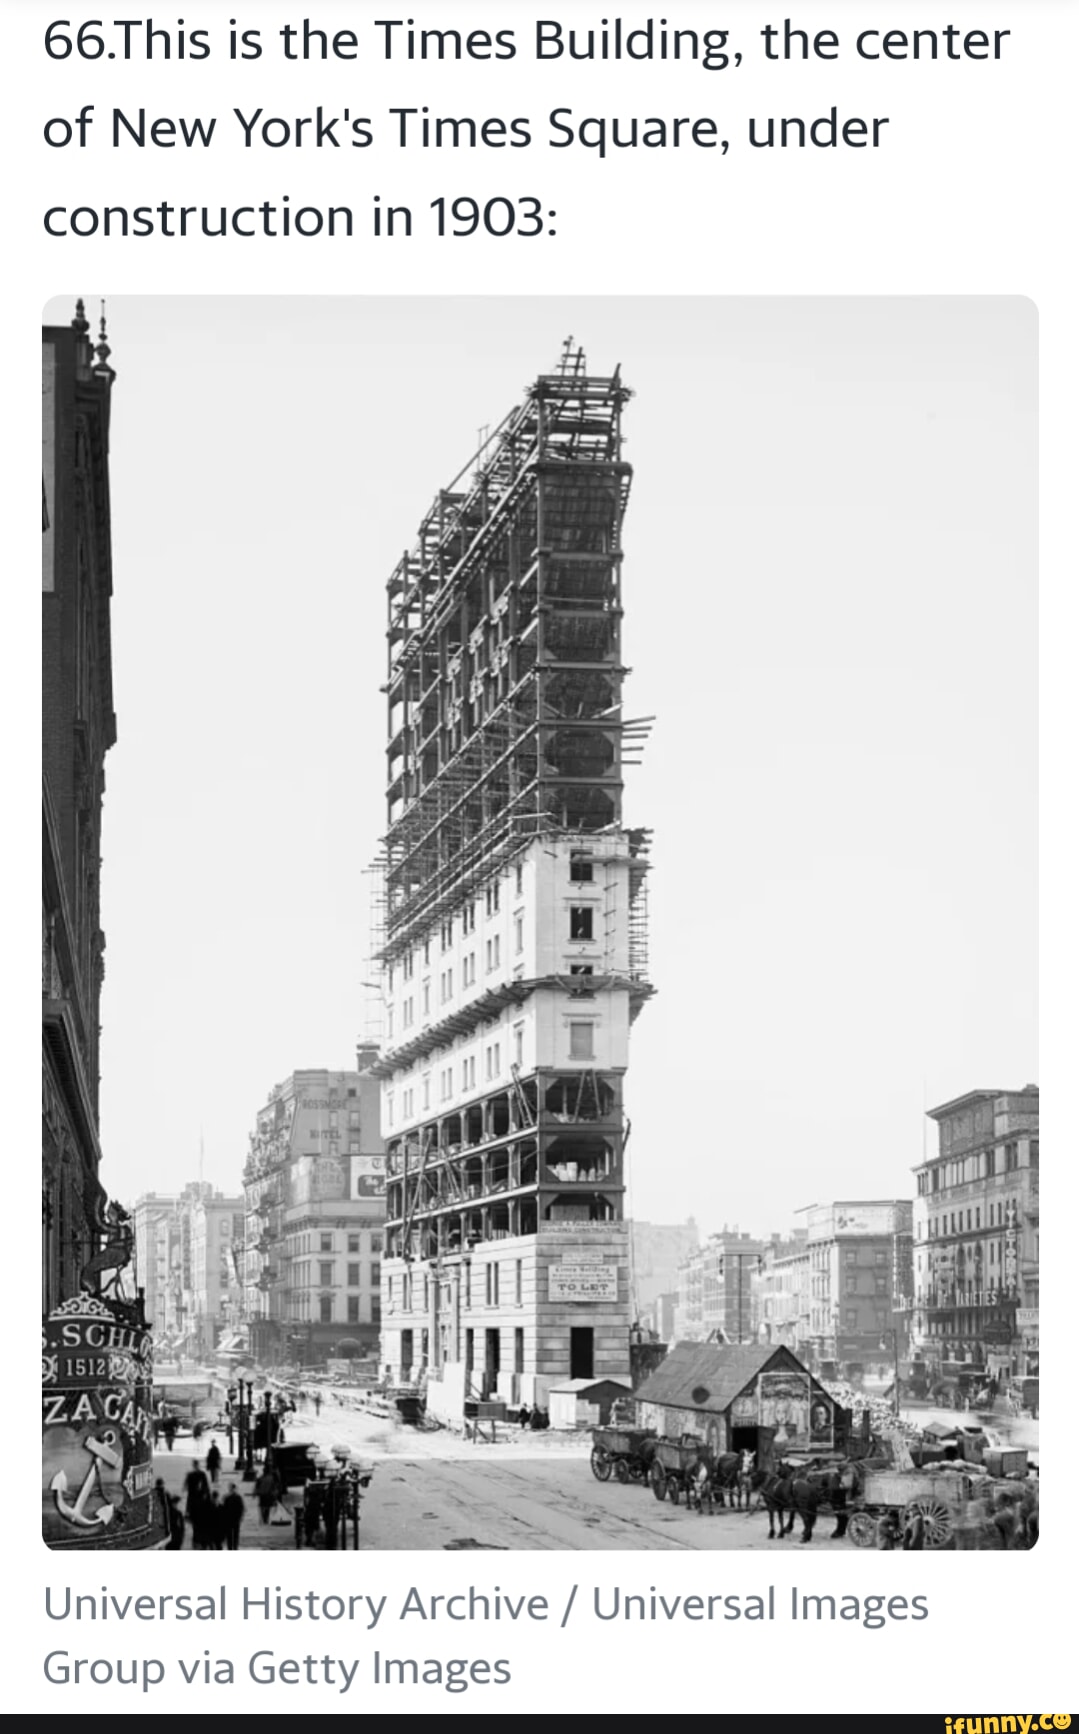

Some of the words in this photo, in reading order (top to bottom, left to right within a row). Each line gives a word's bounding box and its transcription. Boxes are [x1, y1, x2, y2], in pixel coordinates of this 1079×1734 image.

[557, 1283, 576, 1291] TO
[580, 1283, 609, 1291] LET
[67, 1359, 105, 1376] 1512
